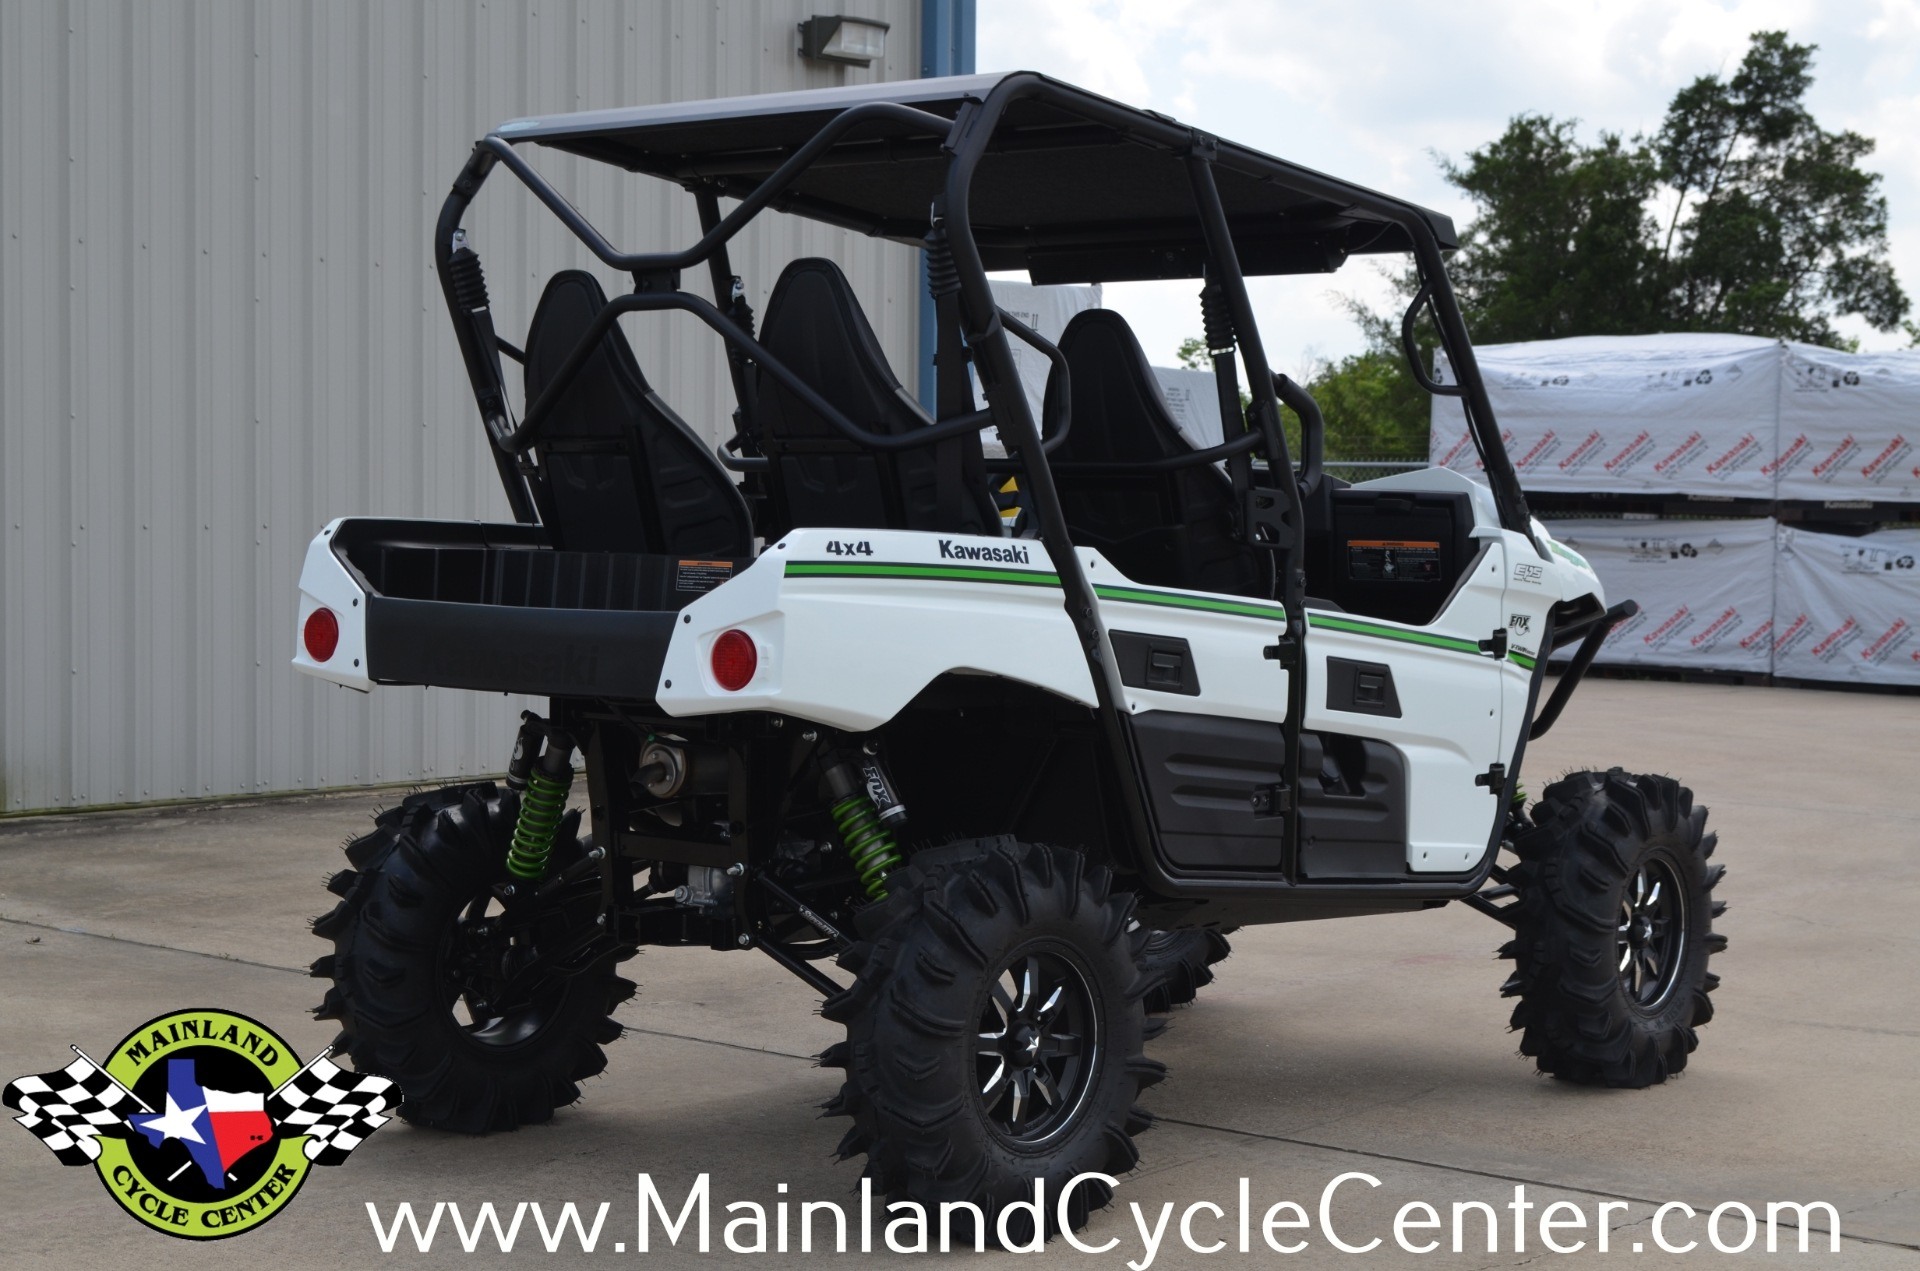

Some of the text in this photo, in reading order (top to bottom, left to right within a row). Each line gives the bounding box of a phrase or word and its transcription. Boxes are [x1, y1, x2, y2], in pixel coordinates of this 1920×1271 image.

[1515, 428, 1555, 469] Kawasaki
[1558, 428, 1600, 470] Kawasaki
[1604, 429, 1650, 471] Kawasaki
[1654, 430, 1702, 473] Kawasaki
[1705, 432, 1756, 474] Kawasaki
[1760, 433, 1807, 476] Kawasaki
[1812, 434, 1854, 477] Kawasaki
[1861, 434, 1905, 478] Kawasaki
[826, 541, 874, 556] 4x4
[938, 539, 1030, 564] Kawasaki
[1508, 613, 1531, 632] FOX
[1643, 603, 1689, 645] Kawasaki
[1690, 605, 1737, 646] Kawasaki
[1740, 618, 1774, 648] Kawas
[1773, 613, 1807, 650] awasaki
[1811, 615, 1856, 656] Kawasaki
[1861, 617, 1906, 660] Kawasaki
[863, 766, 891, 806] FOX
